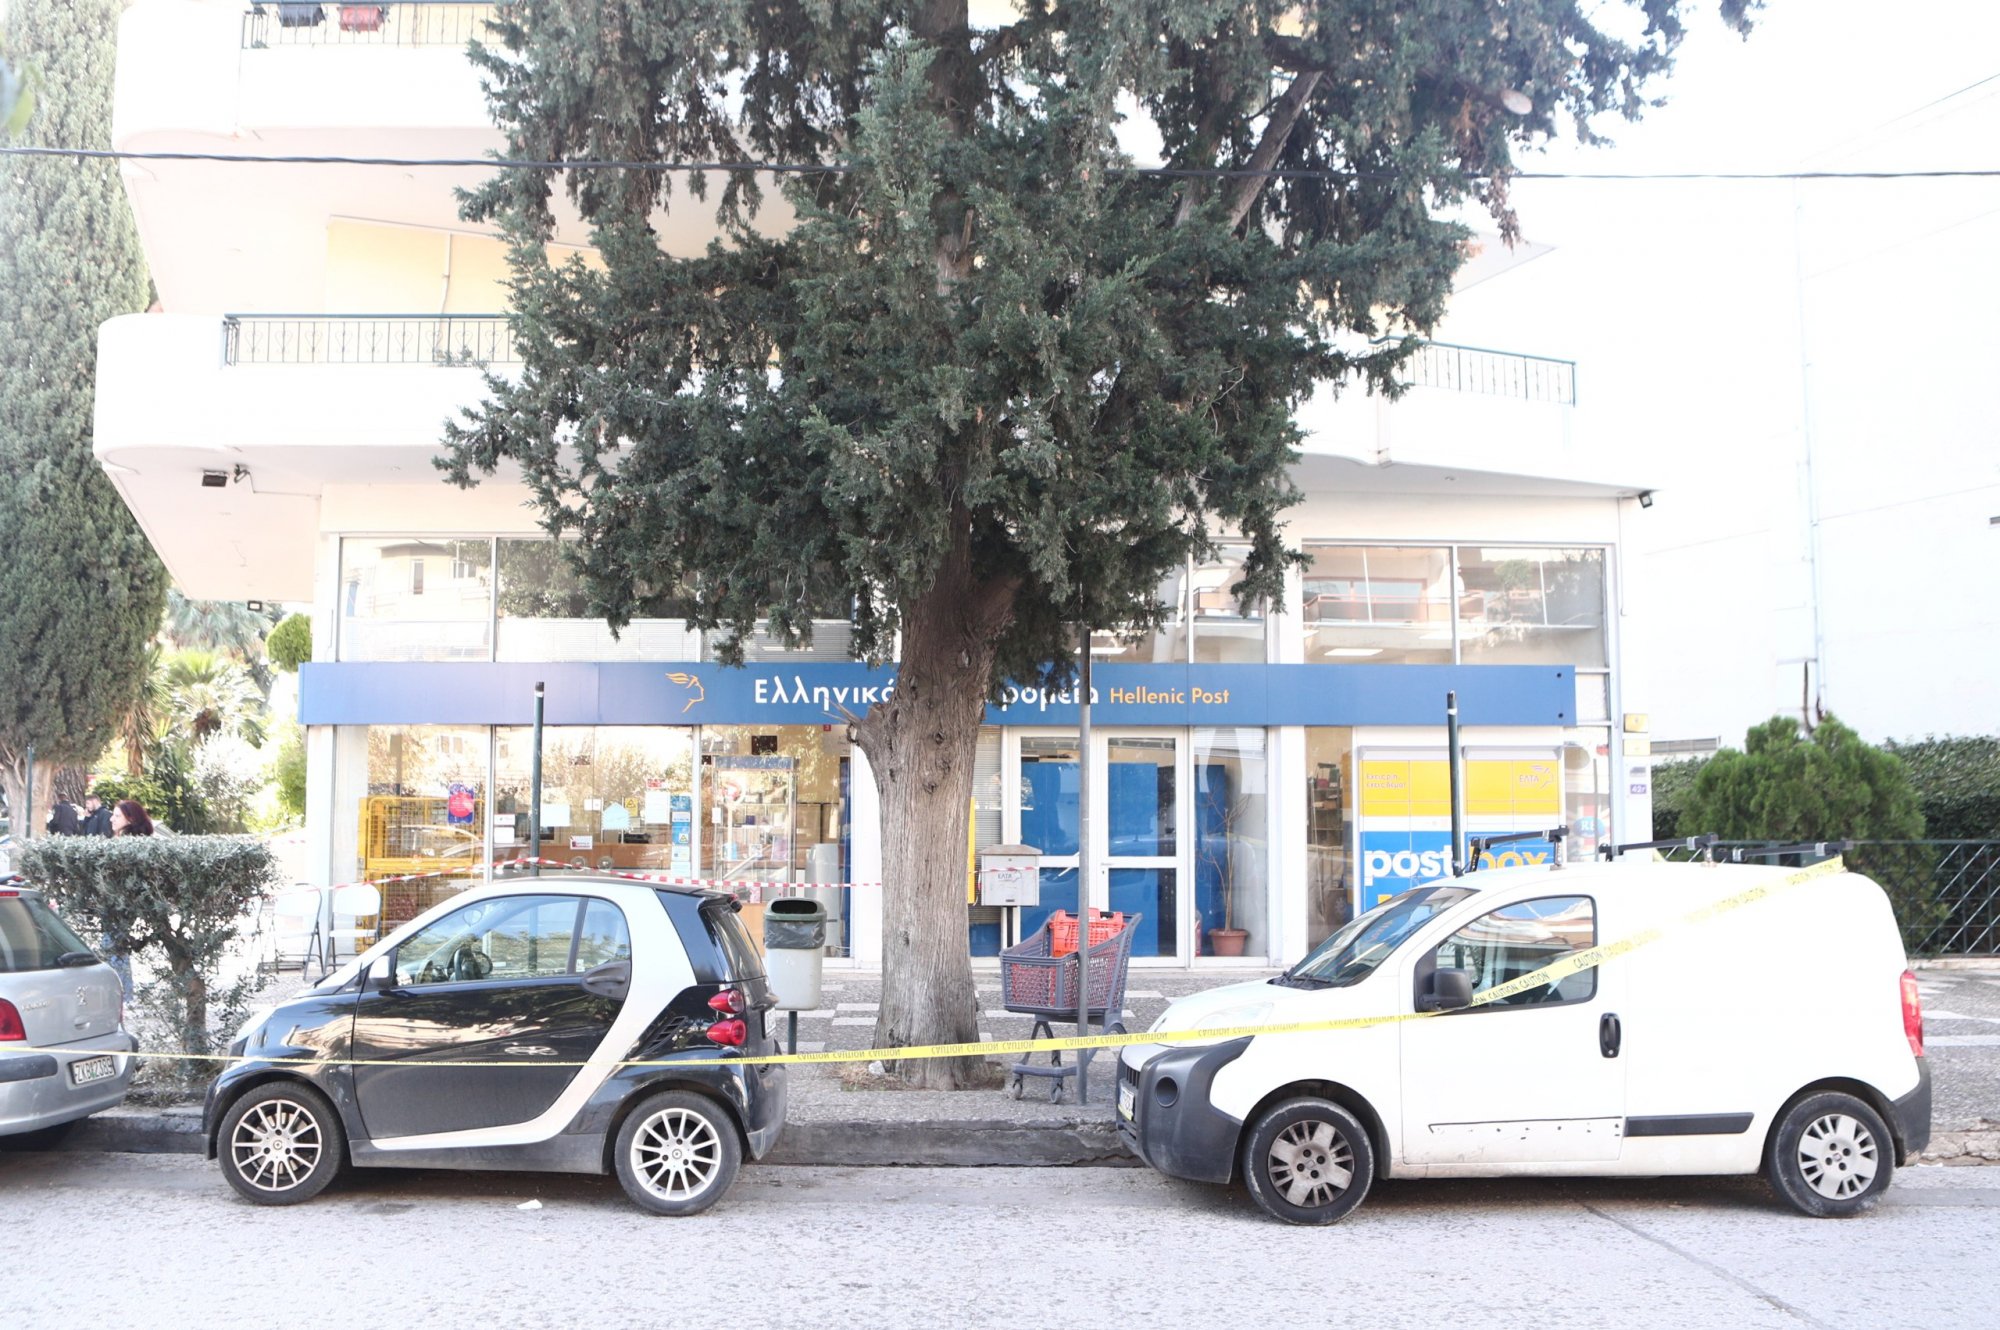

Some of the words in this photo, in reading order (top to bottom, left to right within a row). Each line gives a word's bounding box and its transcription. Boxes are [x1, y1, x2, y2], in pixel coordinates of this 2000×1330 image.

[1110, 686, 1185, 704] Hellenic
[1191, 687, 1230, 704] Post
[1488, 983, 1519, 998] CAUTION
[1519, 971, 1551, 989] CAUTION
[1573, 945, 1604, 969] CAUTION
